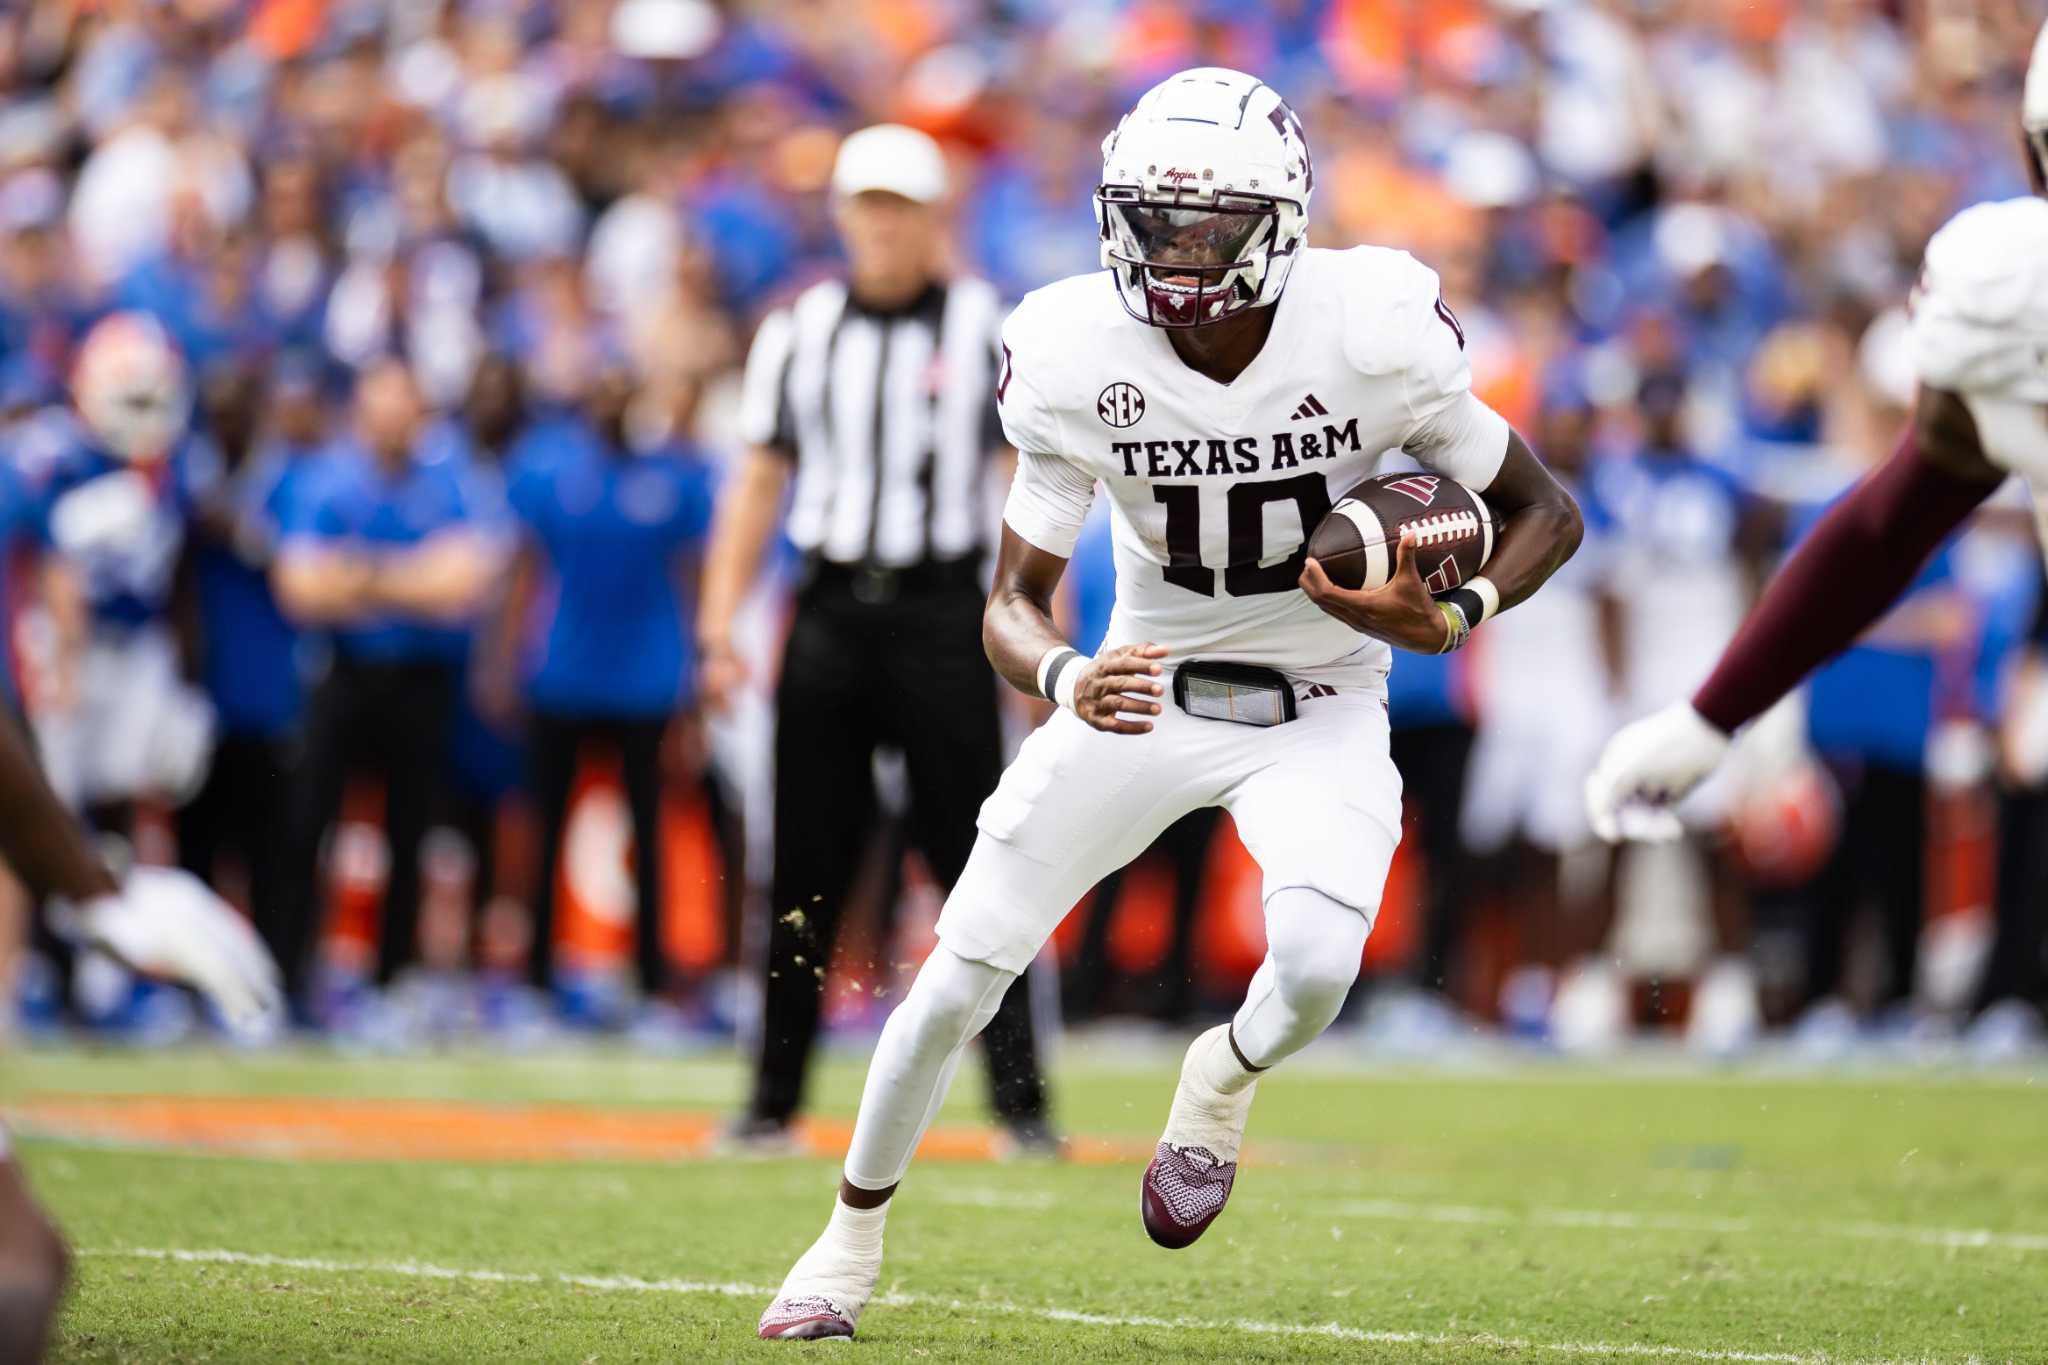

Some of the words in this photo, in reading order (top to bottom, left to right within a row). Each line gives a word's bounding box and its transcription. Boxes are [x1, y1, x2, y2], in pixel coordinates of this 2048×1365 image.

[1163, 167, 1198, 184] Aggies
[1099, 384, 1144, 427] SEC
[1112, 437, 1260, 477] TEXAS
[1272, 418, 1362, 470] A&M
[1152, 471, 1332, 598] 10
